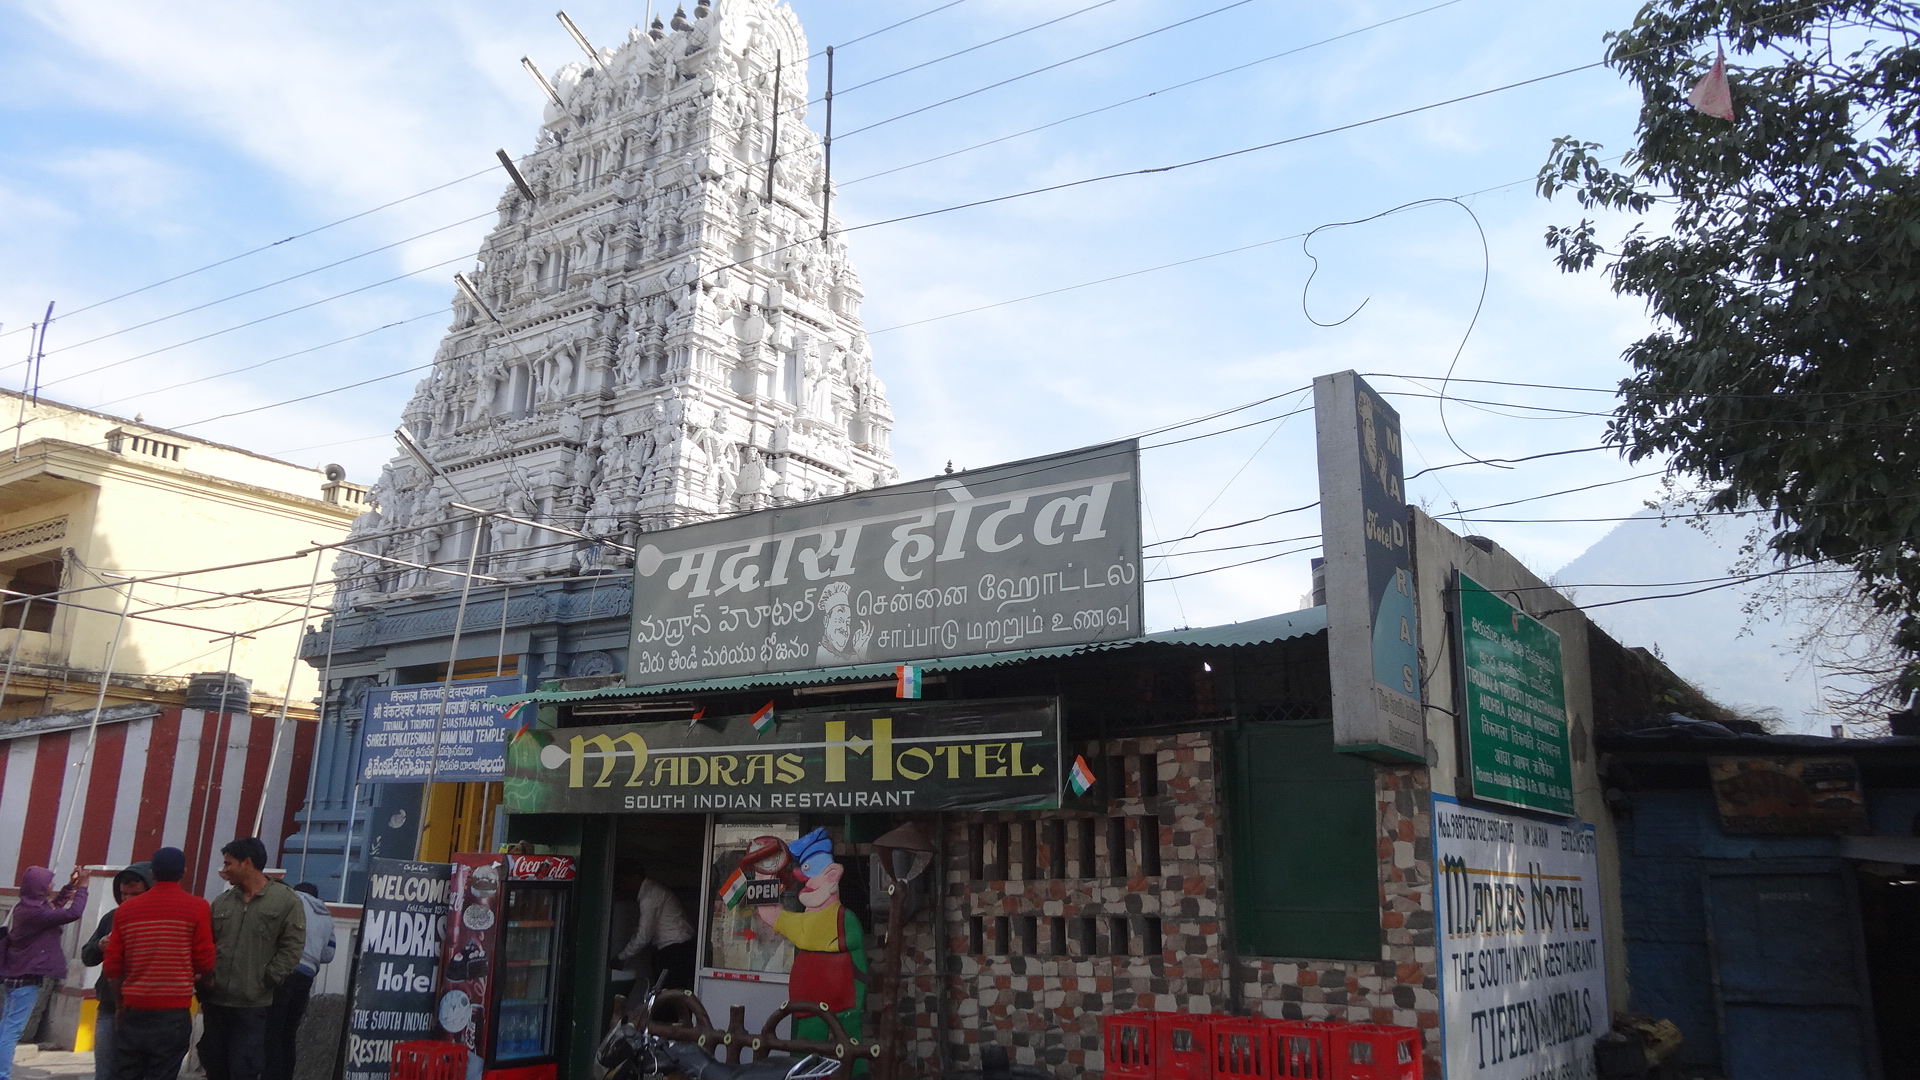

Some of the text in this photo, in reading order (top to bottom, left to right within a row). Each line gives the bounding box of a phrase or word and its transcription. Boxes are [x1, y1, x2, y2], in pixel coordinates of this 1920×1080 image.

[883, 479, 1120, 584] होटल
[1366, 508, 1393, 551] Hotel
[856, 555, 1136, 617] சென்னை ஹோட்டல்
[638, 603, 711, 647] మద్రాస్
[877, 619, 960, 649] சாப்பாடு
[1051, 604, 1130, 632] உணவு
[639, 651, 665, 674] చిరు
[668, 645, 698, 671] తిండి
[1467, 665, 1498, 695] TIRUMALA
[1499, 680, 1524, 706] TIRUPATI
[1479, 693, 1505, 717] ANDHRA
[366, 733, 387, 748] SHREE
[440, 730, 459, 744] WAMI
[458, 729, 475, 744] VARI
[475, 727, 506, 743] TEMPLE
[383, 716, 494, 732] TIRUMALA TIRUPATI EVASTHANAMS
[569, 717, 1043, 788] MADRAS HOTEL
[624, 790, 915, 809] SOUTH INDIAN RESTAURANT
[371, 874, 450, 904] WELCOME
[747, 882, 780, 899] OPEN
[1443, 853, 1590, 939] MADRAS HOTEL
[363, 909, 448, 957] MADRAS
[376, 962, 439, 993] Hotel
[1451, 939, 1597, 992] THE SOUTH INDIAN RESTAURANT
[353, 1009, 435, 1032] THE SOUTH INDIAN
[1471, 999, 1541, 1070] TIFEEN
[1548, 987, 1593, 1046] MEALS
